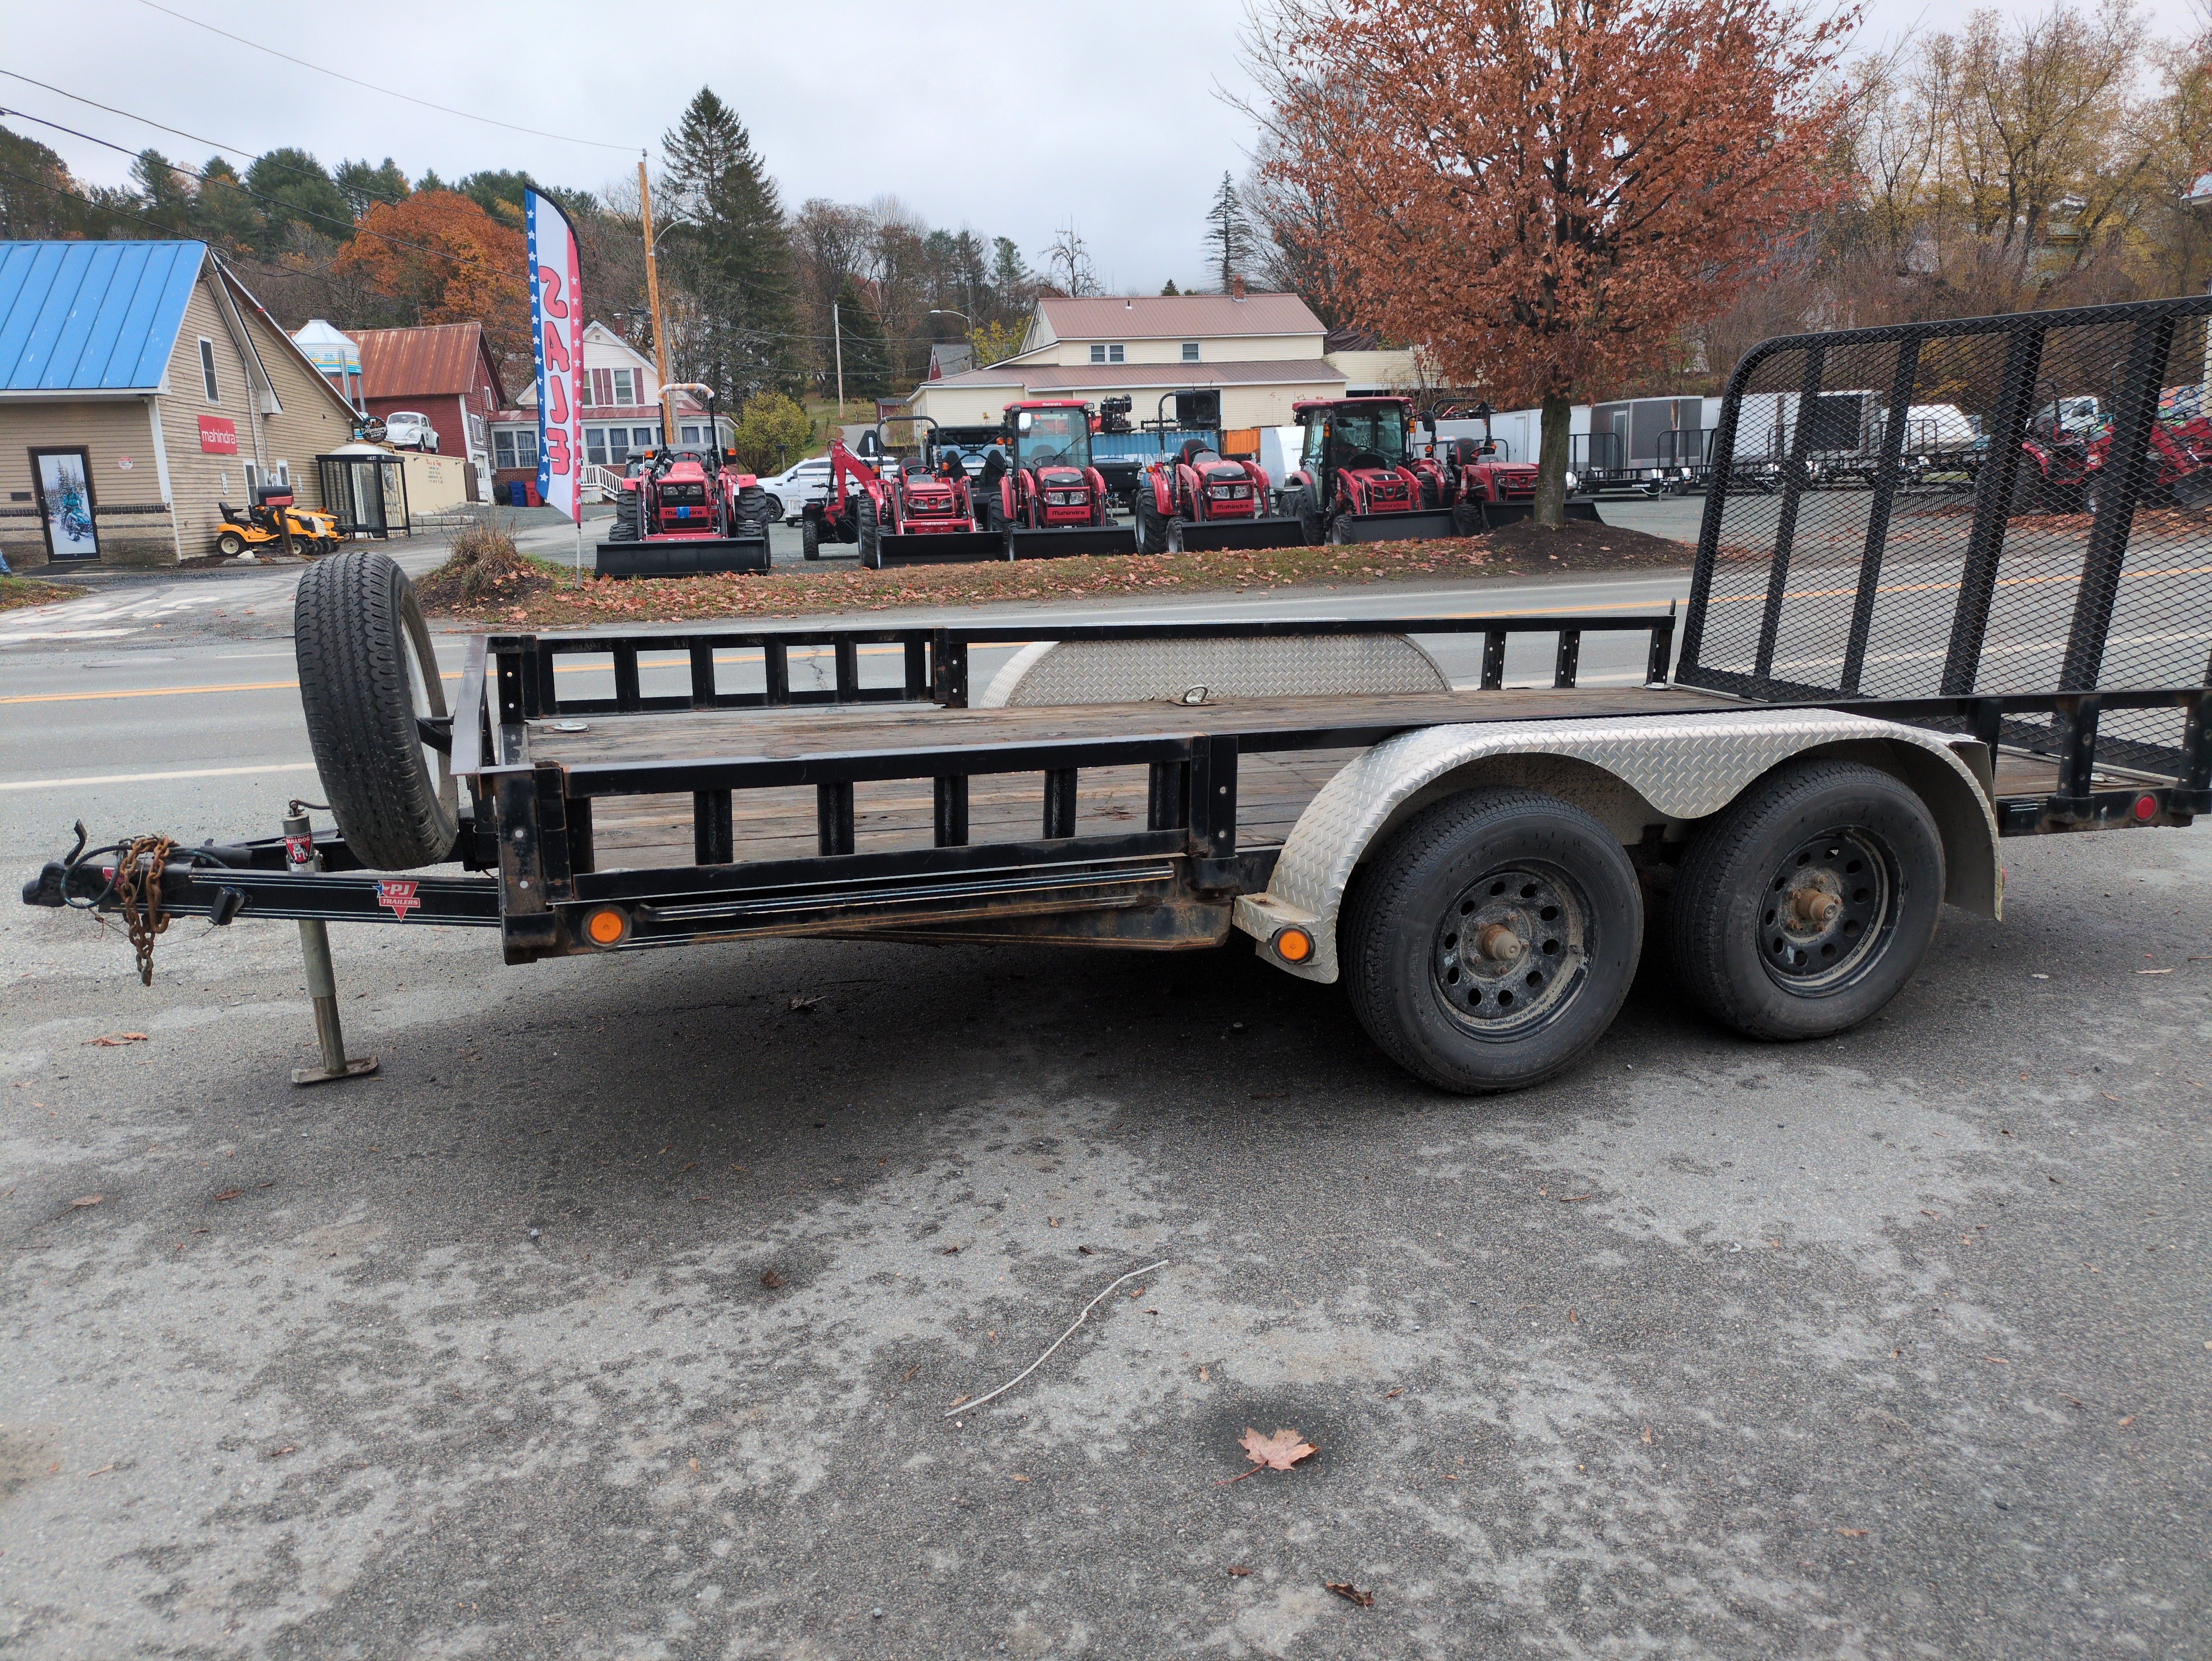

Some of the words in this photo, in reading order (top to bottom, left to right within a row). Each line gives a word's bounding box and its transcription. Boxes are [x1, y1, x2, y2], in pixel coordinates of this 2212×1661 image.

[201, 428, 236, 444] mahindra
[286, 836, 310, 844] BULLDOG
[390, 884, 410, 895] PJ
